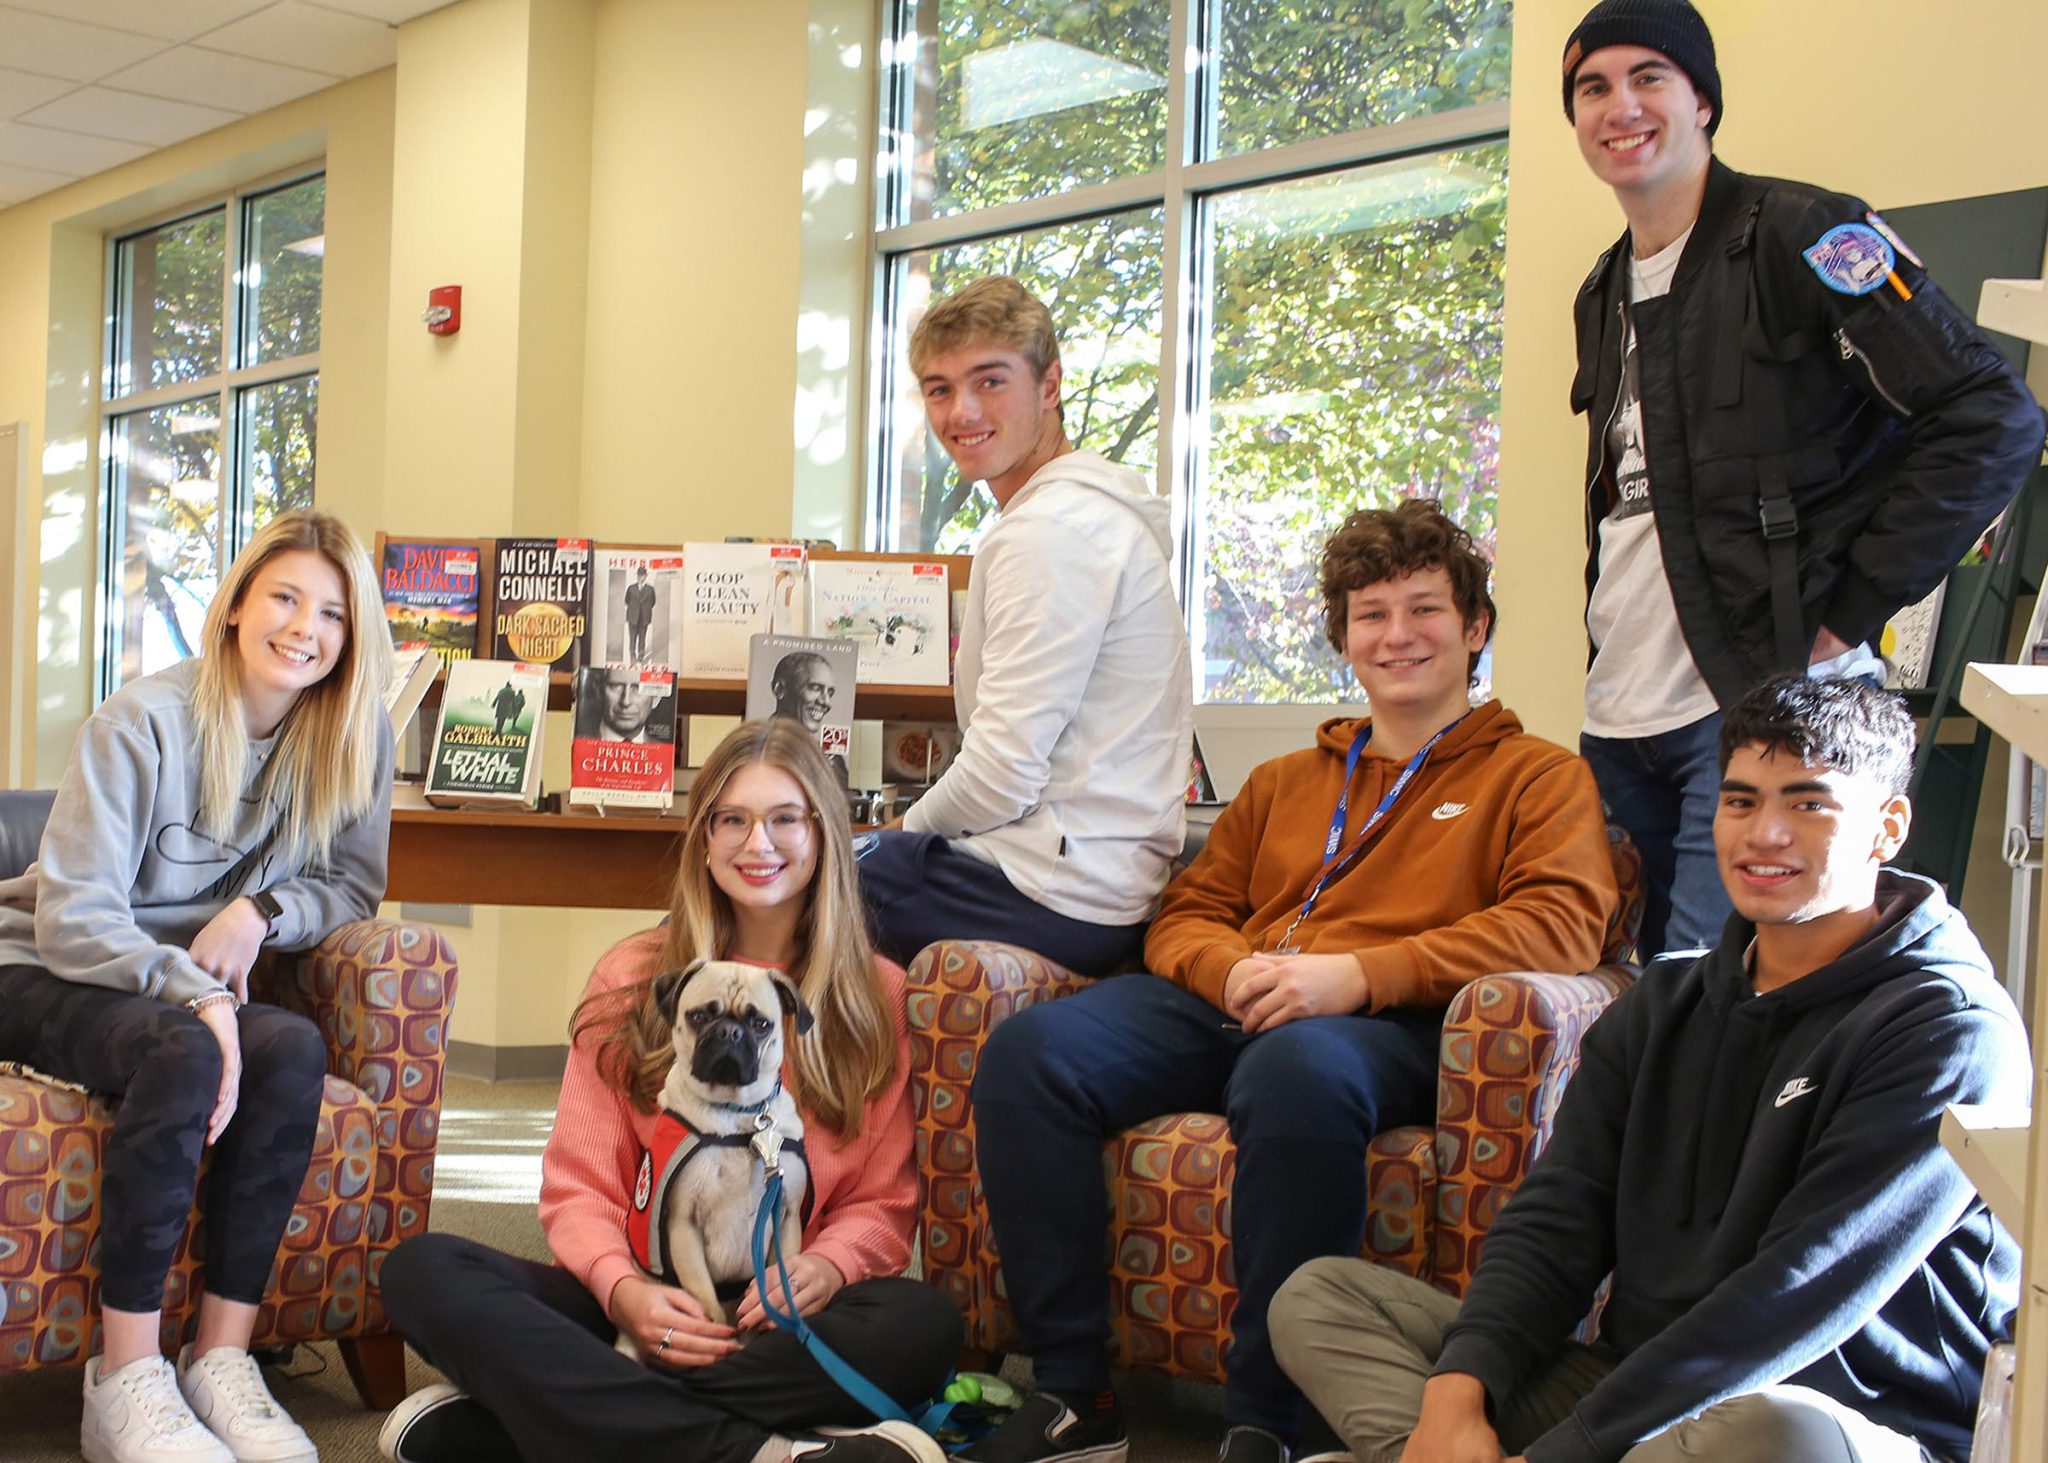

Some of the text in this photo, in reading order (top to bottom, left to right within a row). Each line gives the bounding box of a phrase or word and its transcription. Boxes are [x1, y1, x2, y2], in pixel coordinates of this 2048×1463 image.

[1619, 478, 1650, 502] GIR
[404, 548, 446, 571] DAVI
[500, 549, 588, 575] MICHAEL
[385, 567, 475, 592] BALDACCI
[696, 572, 744, 584] GOOP
[499, 575, 587, 602] CONNELLY
[696, 587, 750, 600] CLEAN
[696, 601, 760, 615] BEAUTY
[497, 614, 585, 637] DARK SACRED
[520, 636, 559, 657] NIGHT
[773, 639, 823, 651] PROMISED
[826, 645, 852, 654] LAND
[453, 723, 494, 735] ROBERT
[444, 731, 528, 748] GALBRAITH
[442, 749, 511, 769] LETHAL
[597, 746, 649, 761] PRINCE
[451, 764, 520, 785] WHITE
[582, 758, 663, 776] CHARLES
[1440, 801, 1467, 815] NIKE
